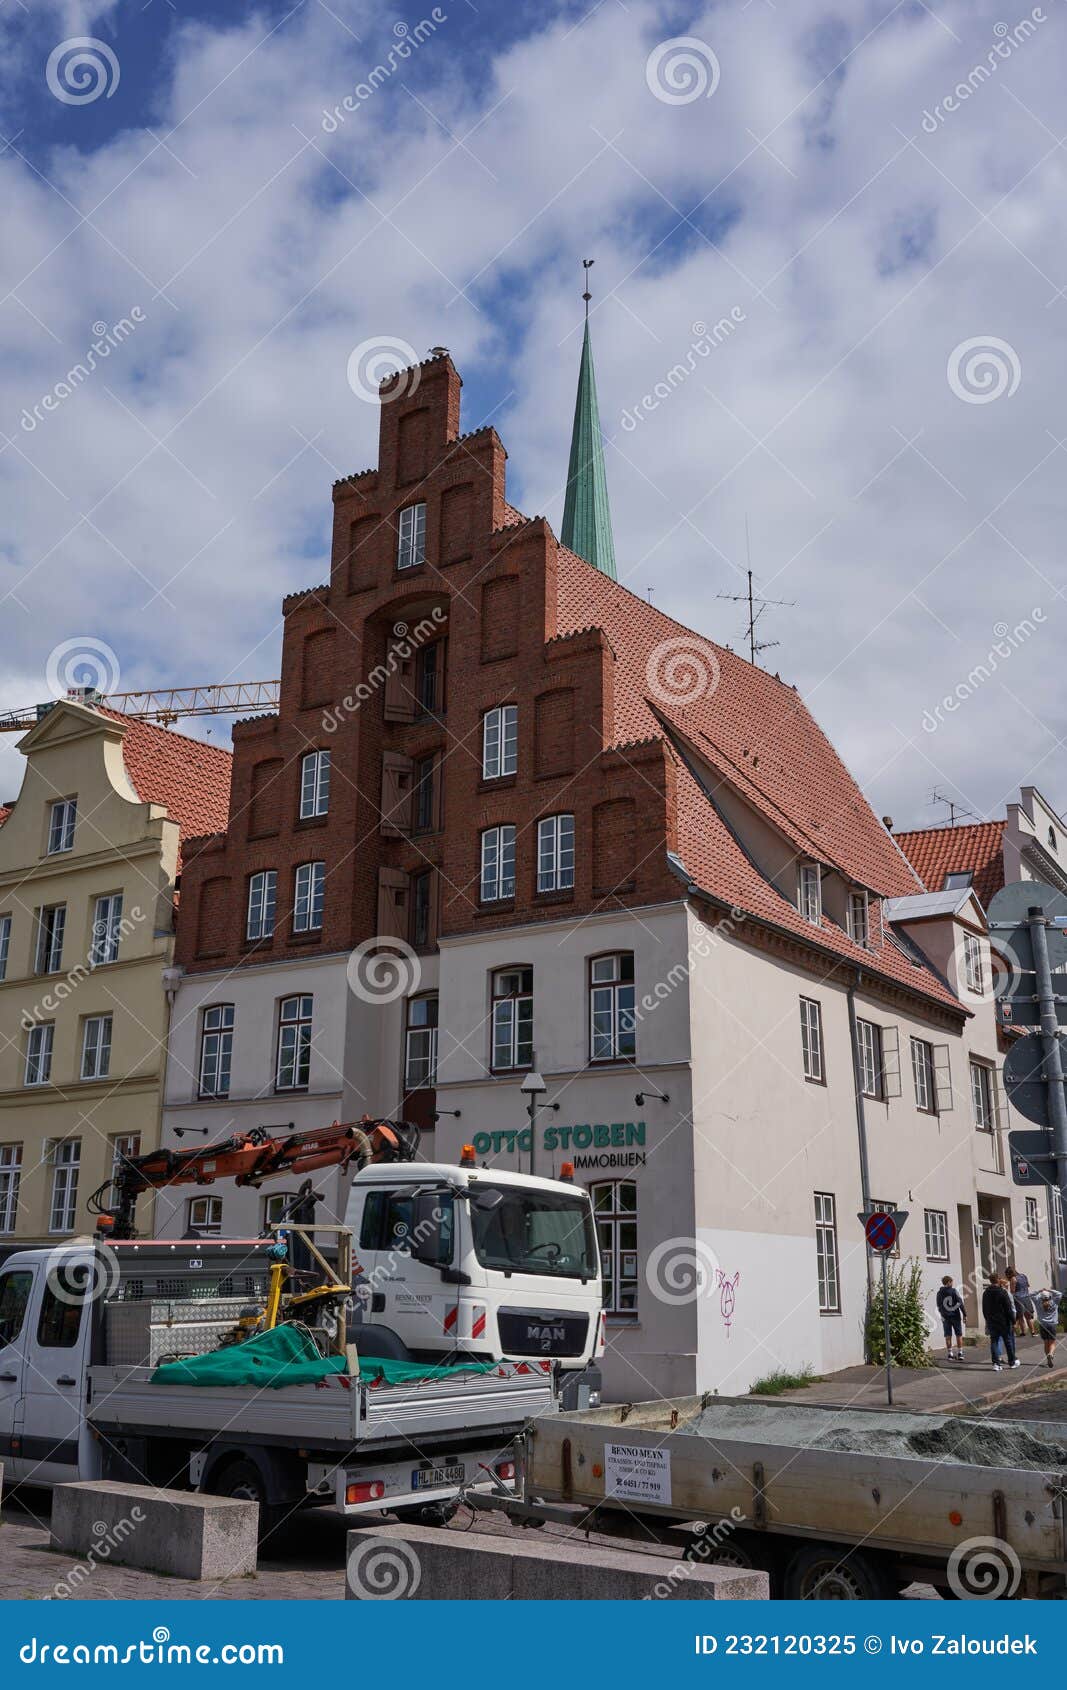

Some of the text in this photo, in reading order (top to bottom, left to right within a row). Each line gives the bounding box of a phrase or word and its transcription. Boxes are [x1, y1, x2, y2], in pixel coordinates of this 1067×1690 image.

[472, 1122, 646, 1154] OTTO STÖBEN
[573, 1152, 647, 1169] IMMOBILIEN
[527, 1326, 565, 1340] MAN
[611, 1446, 663, 1459] BENNO MEYN
[418, 1471, 428, 1484] HL
